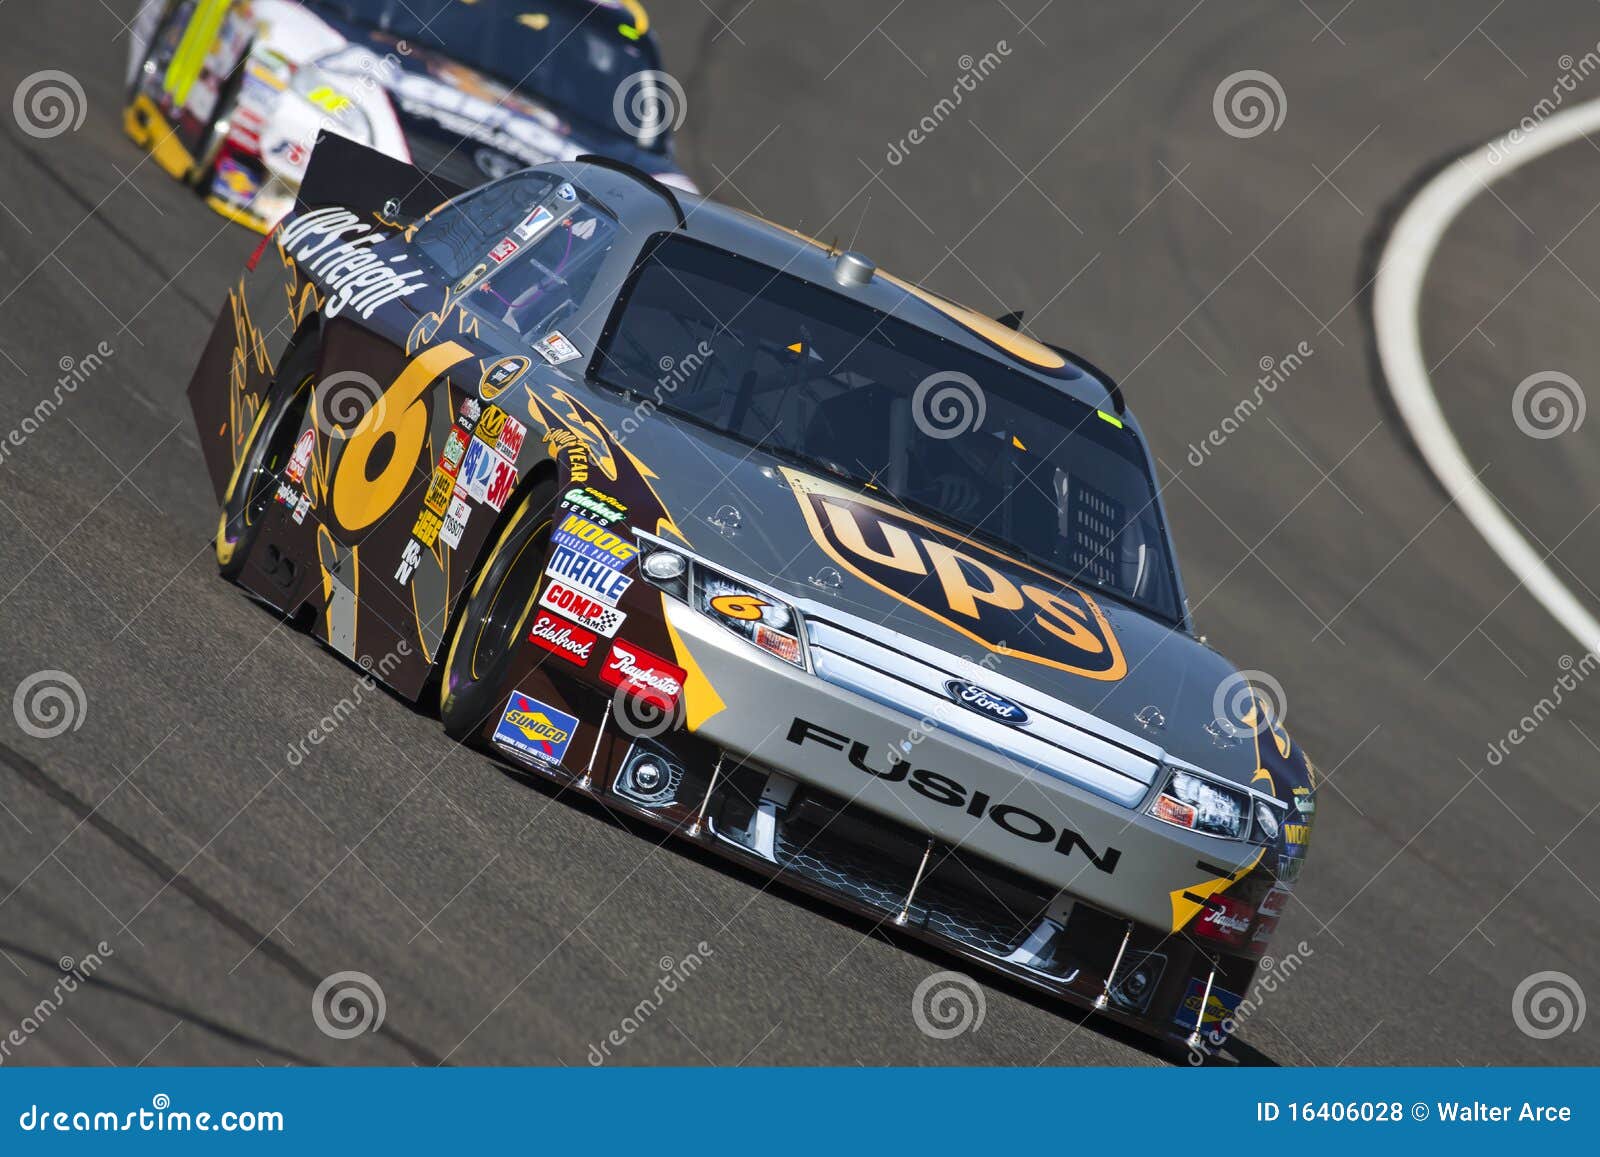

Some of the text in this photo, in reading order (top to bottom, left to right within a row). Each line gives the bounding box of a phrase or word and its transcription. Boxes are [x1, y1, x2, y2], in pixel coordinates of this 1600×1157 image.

[278, 207, 428, 319] UPS Freight
[333, 340, 475, 531] 6
[459, 416, 473, 430] POLE
[487, 462, 517, 509] 3M
[444, 514, 465, 538] TISSOT
[560, 500, 609, 527] BELTS
[554, 532, 622, 568] CHASSIS PARTS
[559, 514, 641, 560] MOOG
[549, 547, 632, 600] MAHLE
[823, 499, 1104, 654] ups
[546, 584, 604, 619] COMP
[710, 595, 772, 621] 6
[532, 617, 593, 660] Edelbrock
[578, 615, 607, 632] CAMS
[609, 646, 680, 695] Raybestos
[961, 686, 1015, 717] Ford
[507, 711, 565, 742] SUNOCO
[515, 740, 528, 751] FUEL
[786, 717, 1122, 875] FUSION
